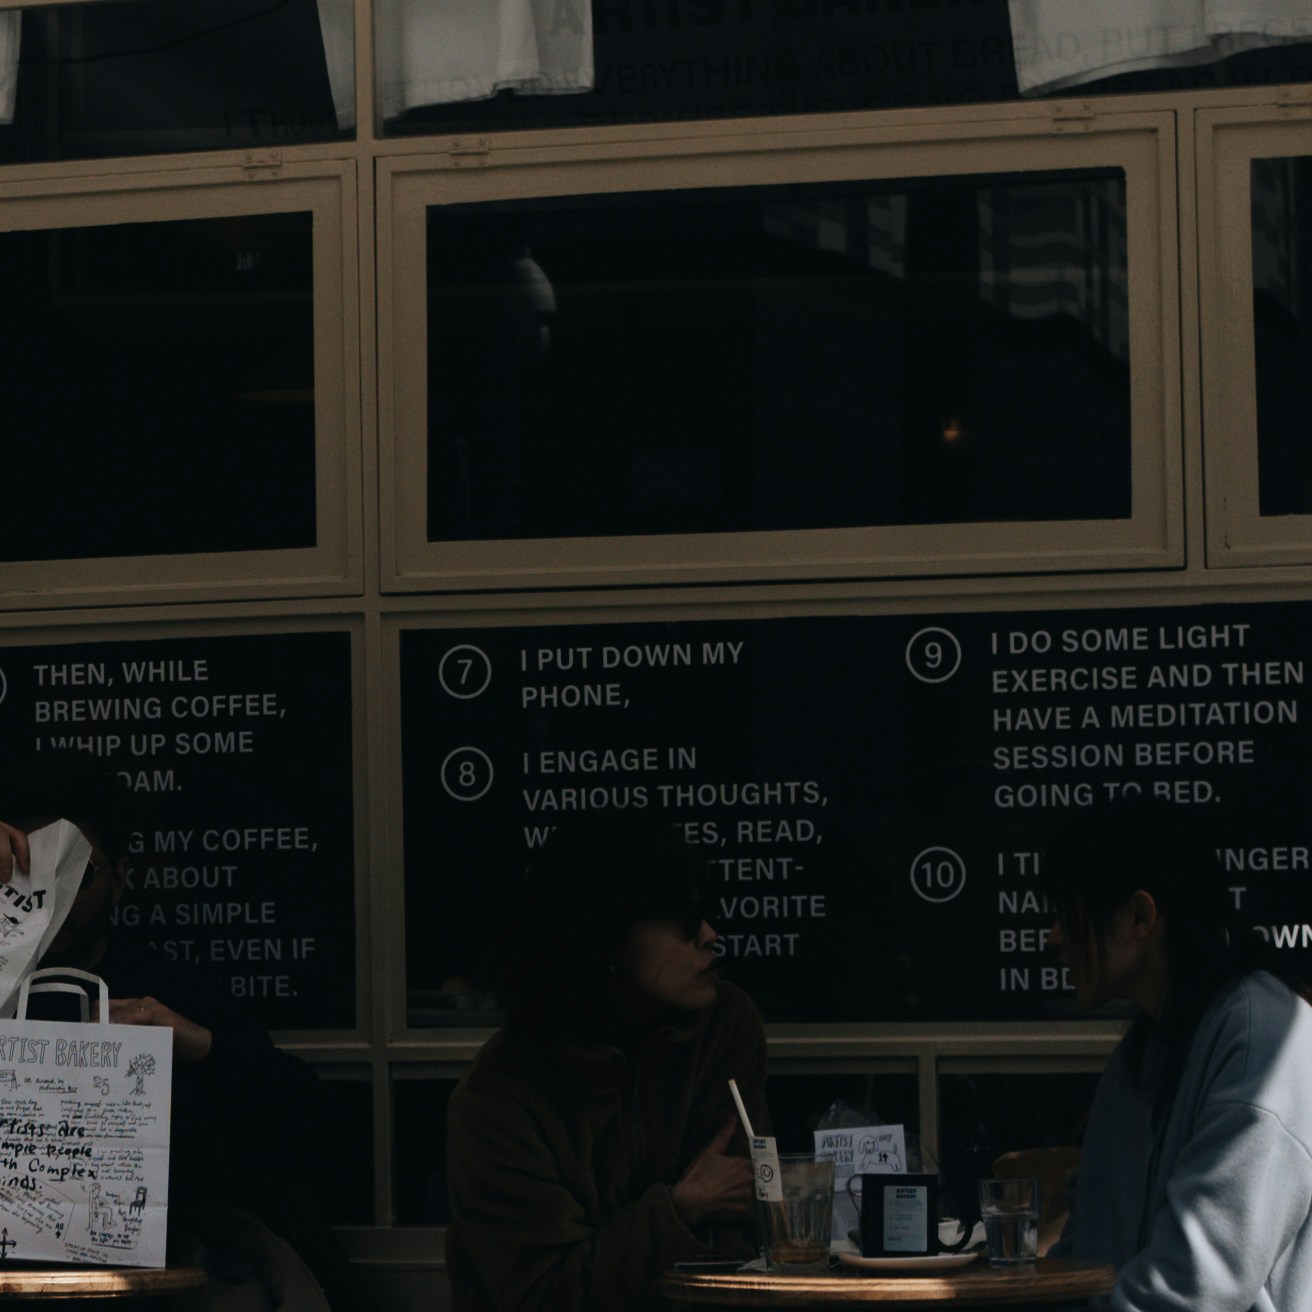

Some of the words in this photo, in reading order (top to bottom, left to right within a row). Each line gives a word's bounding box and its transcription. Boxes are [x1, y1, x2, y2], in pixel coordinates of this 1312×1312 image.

[991, 632, 998, 655] I
[1009, 630, 1052, 654] DO
[1061, 627, 1149, 653] SOME
[1159, 623, 1251, 650] LIGHT
[521, 649, 527, 672] I
[537, 647, 593, 671] PUT
[602, 643, 691, 669] DOWN
[702, 641, 744, 665] MY
[33, 662, 114, 688] THEN,
[121, 659, 209, 684] WHILE
[992, 666, 1137, 694] EXERCISE
[1147, 663, 1212, 689] AND
[1221, 661, 1304, 686] THEN
[35, 697, 162, 723] BREWING
[171, 693, 286, 718] COFFEE,
[521, 683, 630, 709] PHONE,
[993, 706, 1072, 732] HAVE
[1081, 705, 1101, 729] A
[1110, 700, 1297, 728] MEDITATION
[130, 733, 166, 756] UP
[175, 730, 254, 755] SOME
[993, 743, 1124, 770] SESSION
[1135, 740, 1255, 766] BEFORE
[523, 752, 529, 774] I
[539, 748, 659, 774] ENGAGE
[668, 746, 696, 770] IN
[522, 785, 649, 811] VARIOUS
[657, 780, 828, 808] THOUGHTS,
[994, 783, 1093, 808] GOING
[1153, 780, 1221, 804] BED.
[154, 830, 194, 853] MY
[202, 827, 318, 853] COFFEE,
[737, 819, 823, 845] READ,
[143, 865, 238, 889] ABOUT
[921, 861, 955, 888] 10
[997, 852, 1004, 876] I
[149, 903, 167, 926] A
[175, 901, 276, 925] SIMPLE
[210, 938, 282, 961] EVEN
[292, 937, 316, 960] IF
[230, 975, 298, 998] BITE.
[1000, 967, 1030, 991] IN
[55, 1038, 122, 1068] BAKERY
